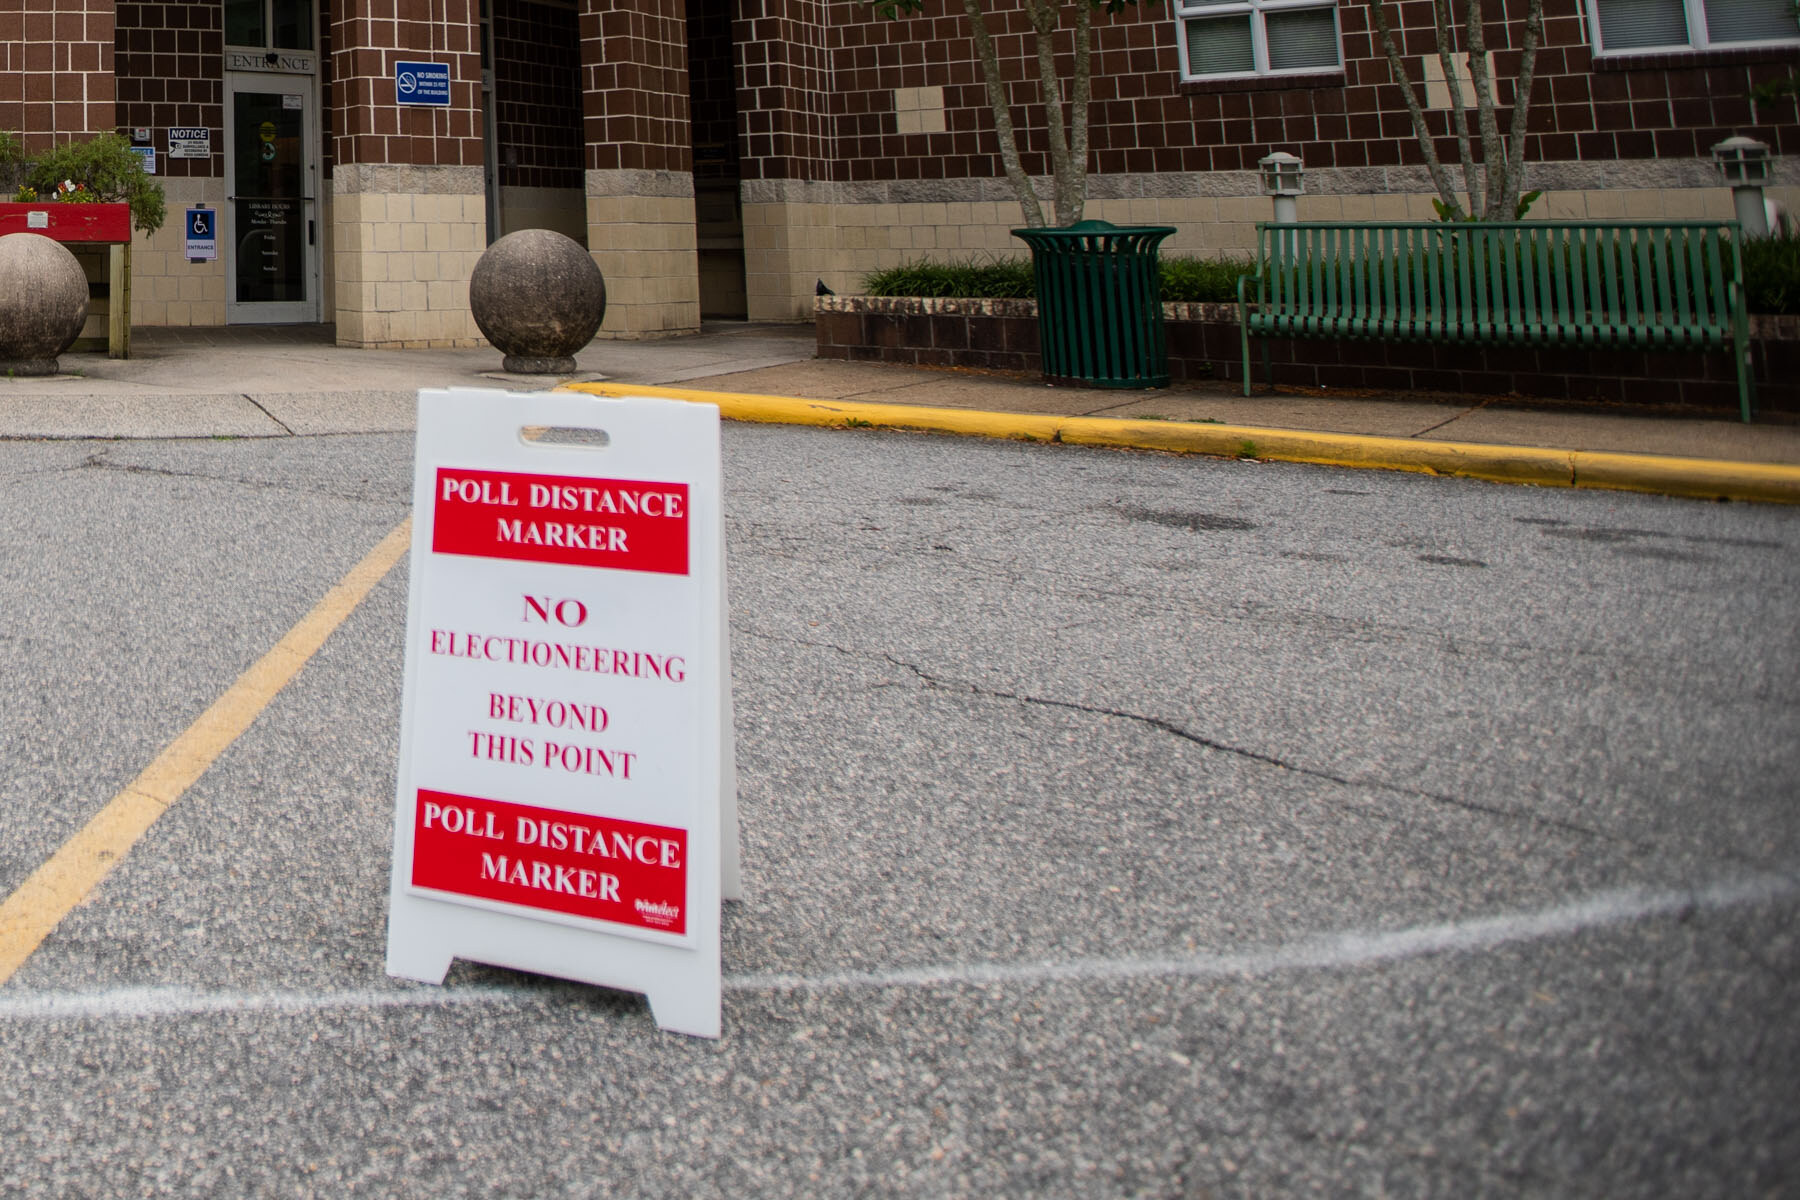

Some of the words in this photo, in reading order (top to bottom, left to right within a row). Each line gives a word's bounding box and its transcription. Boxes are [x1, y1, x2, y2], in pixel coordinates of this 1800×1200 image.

[233, 54, 309, 71] ENTRANCE
[171, 129, 207, 139] NOTICE
[442, 477, 519, 507] POLL
[529, 483, 684, 519] DISTANCE
[496, 517, 629, 553] MARKER
[521, 594, 588, 628] NO
[430, 628, 686, 683] ELECTIONEERING
[488, 692, 610, 733] BEYOND
[467, 730, 535, 767] THIS
[543, 741, 637, 781] POINT
[423, 801, 504, 840] POLL
[516, 816, 681, 869] DISTANCE
[481, 852, 622, 903] MARKER
